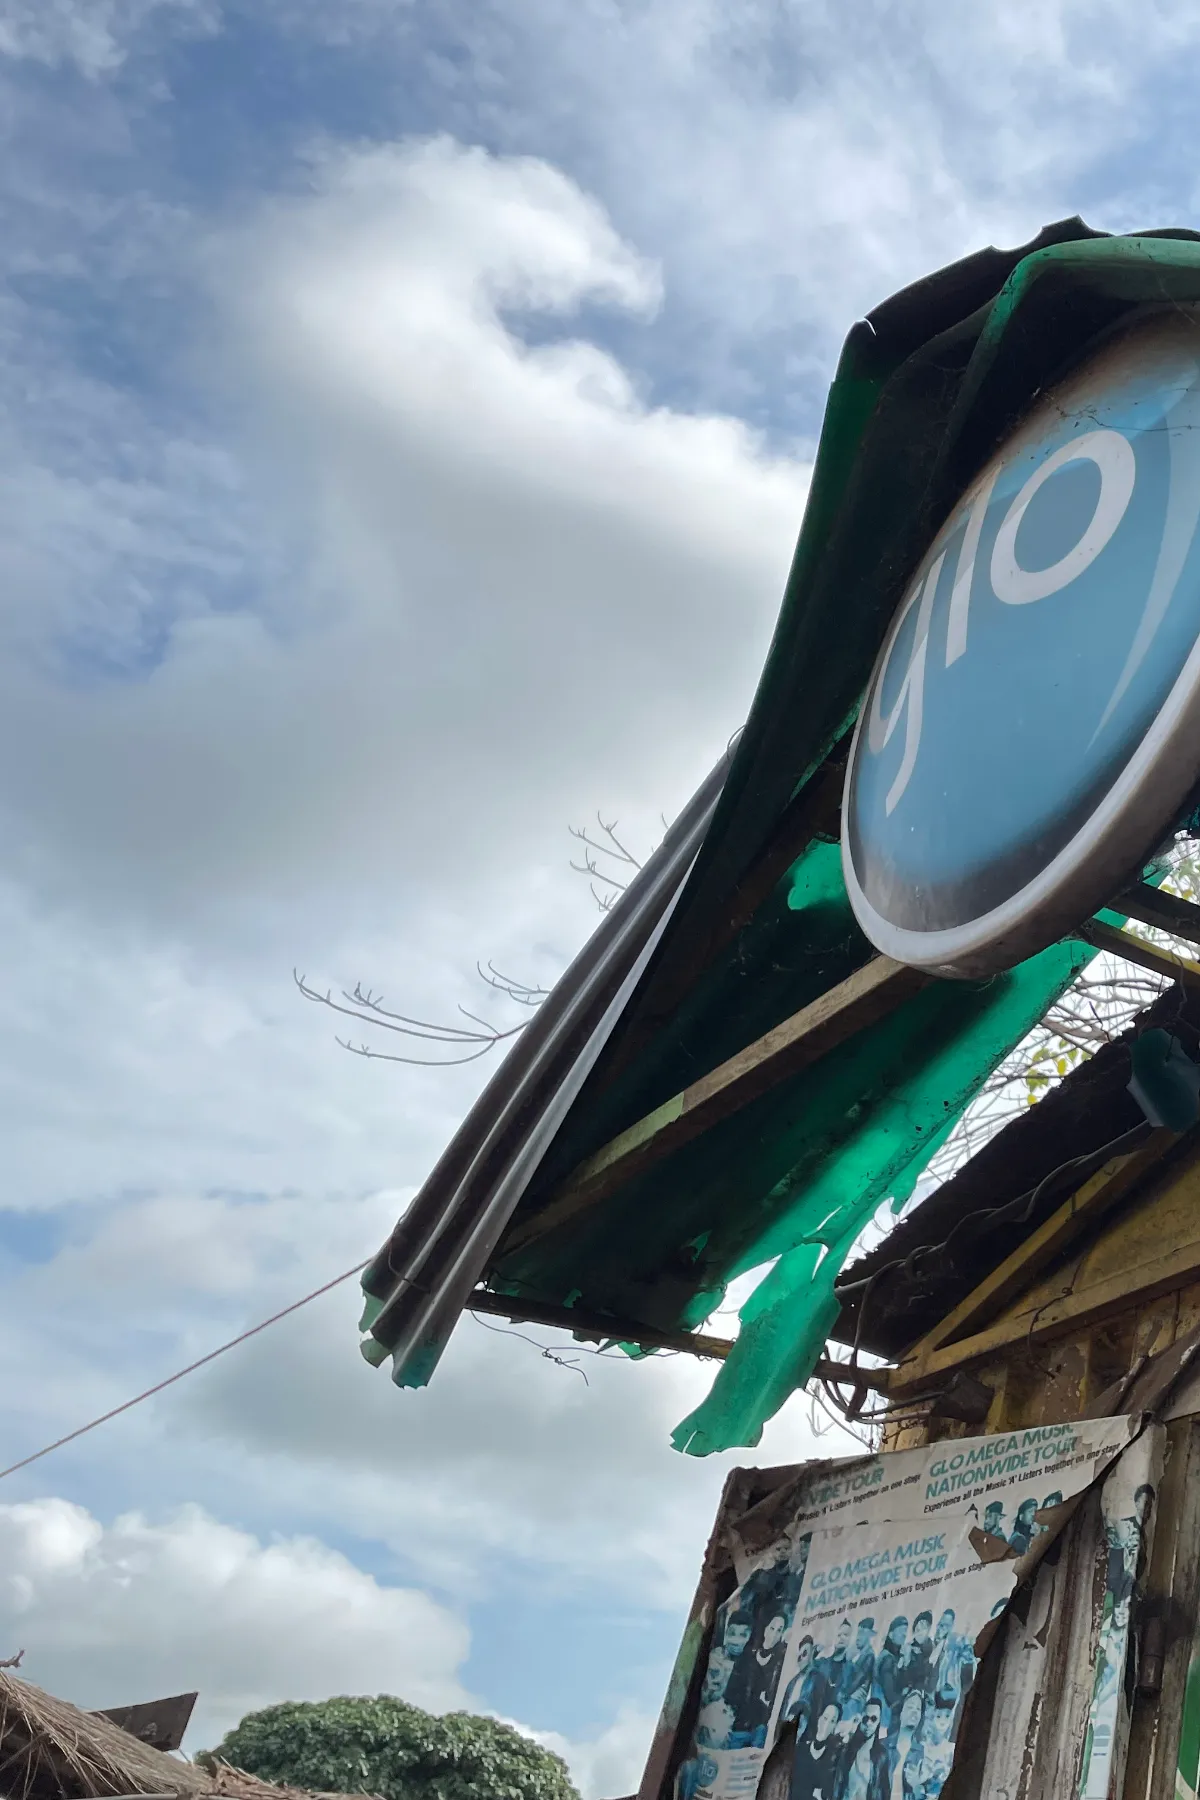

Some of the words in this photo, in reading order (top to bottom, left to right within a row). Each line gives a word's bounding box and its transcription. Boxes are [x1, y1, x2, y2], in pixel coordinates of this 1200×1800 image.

[868, 430, 1135, 818] glo
[926, 1451, 1030, 1500] NATIONWIDE
[1034, 1436, 1079, 1464] TOUR
[930, 1453, 964, 1478] GLO
[968, 1437, 1018, 1464] MEGA
[805, 1566, 903, 1611] NATIONWIDE
[904, 1552, 949, 1580] TOUR
[810, 1566, 841, 1590] GLO
[843, 1549, 891, 1582] MEGA
